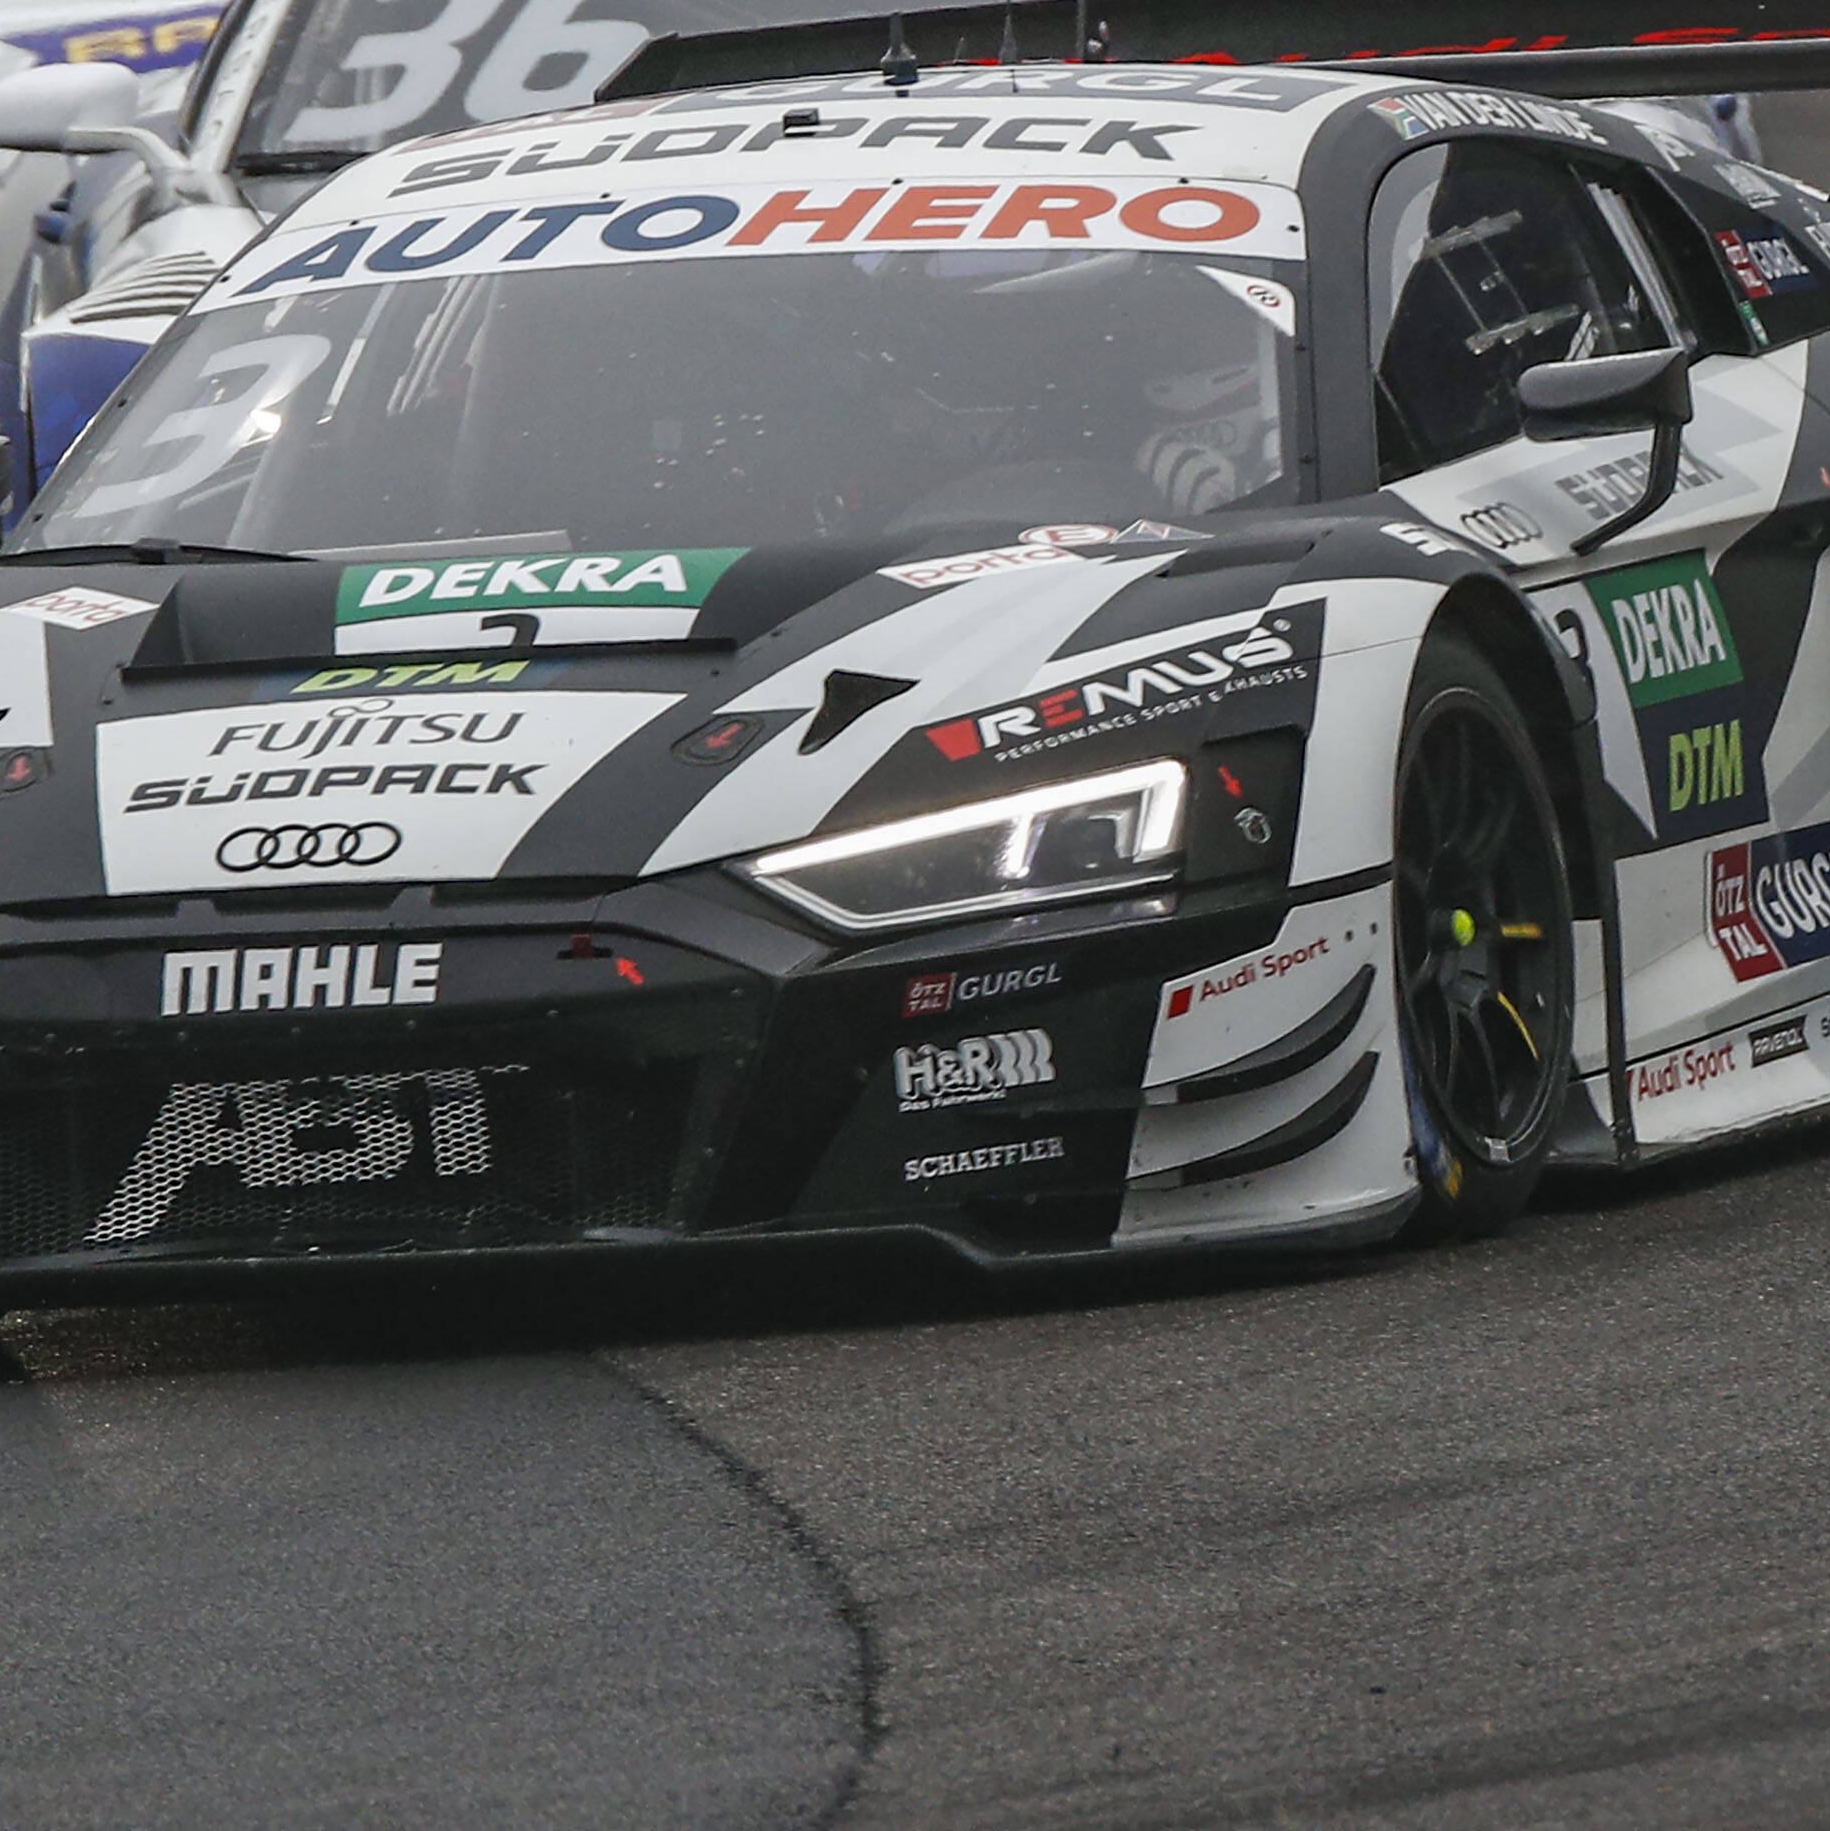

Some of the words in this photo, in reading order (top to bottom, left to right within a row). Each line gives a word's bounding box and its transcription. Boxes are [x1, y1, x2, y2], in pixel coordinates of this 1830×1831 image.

[389, 115, 1201, 198] SÜDPACK
[229, 183, 1262, 298] AUTOHERO
[359, 553, 689, 609] DEKRA
[1611, 577, 1727, 684] DEKRA
[291, 658, 533, 695] DTM
[977, 626, 1295, 750] REMUS
[207, 700, 528, 761] FUJITSU
[993, 713, 1137, 764] PERFORMANCE
[1139, 694, 1202, 722] SPORT
[123, 762, 551, 815] SÜDPACK
[1669, 718, 1745, 812] DTM
[1197, 967, 1258, 1005] Audi
[1259, 934, 1331, 980] Sport
[1718, 922, 1768, 962] TAL
[161, 942, 444, 1018] MAHLE
[957, 962, 1063, 1001] GURGL
[1637, 1059, 1682, 1102] Audi
[1682, 1040, 1737, 1091] Sport
[904, 1135, 1066, 1182] SCHAEFFLER
